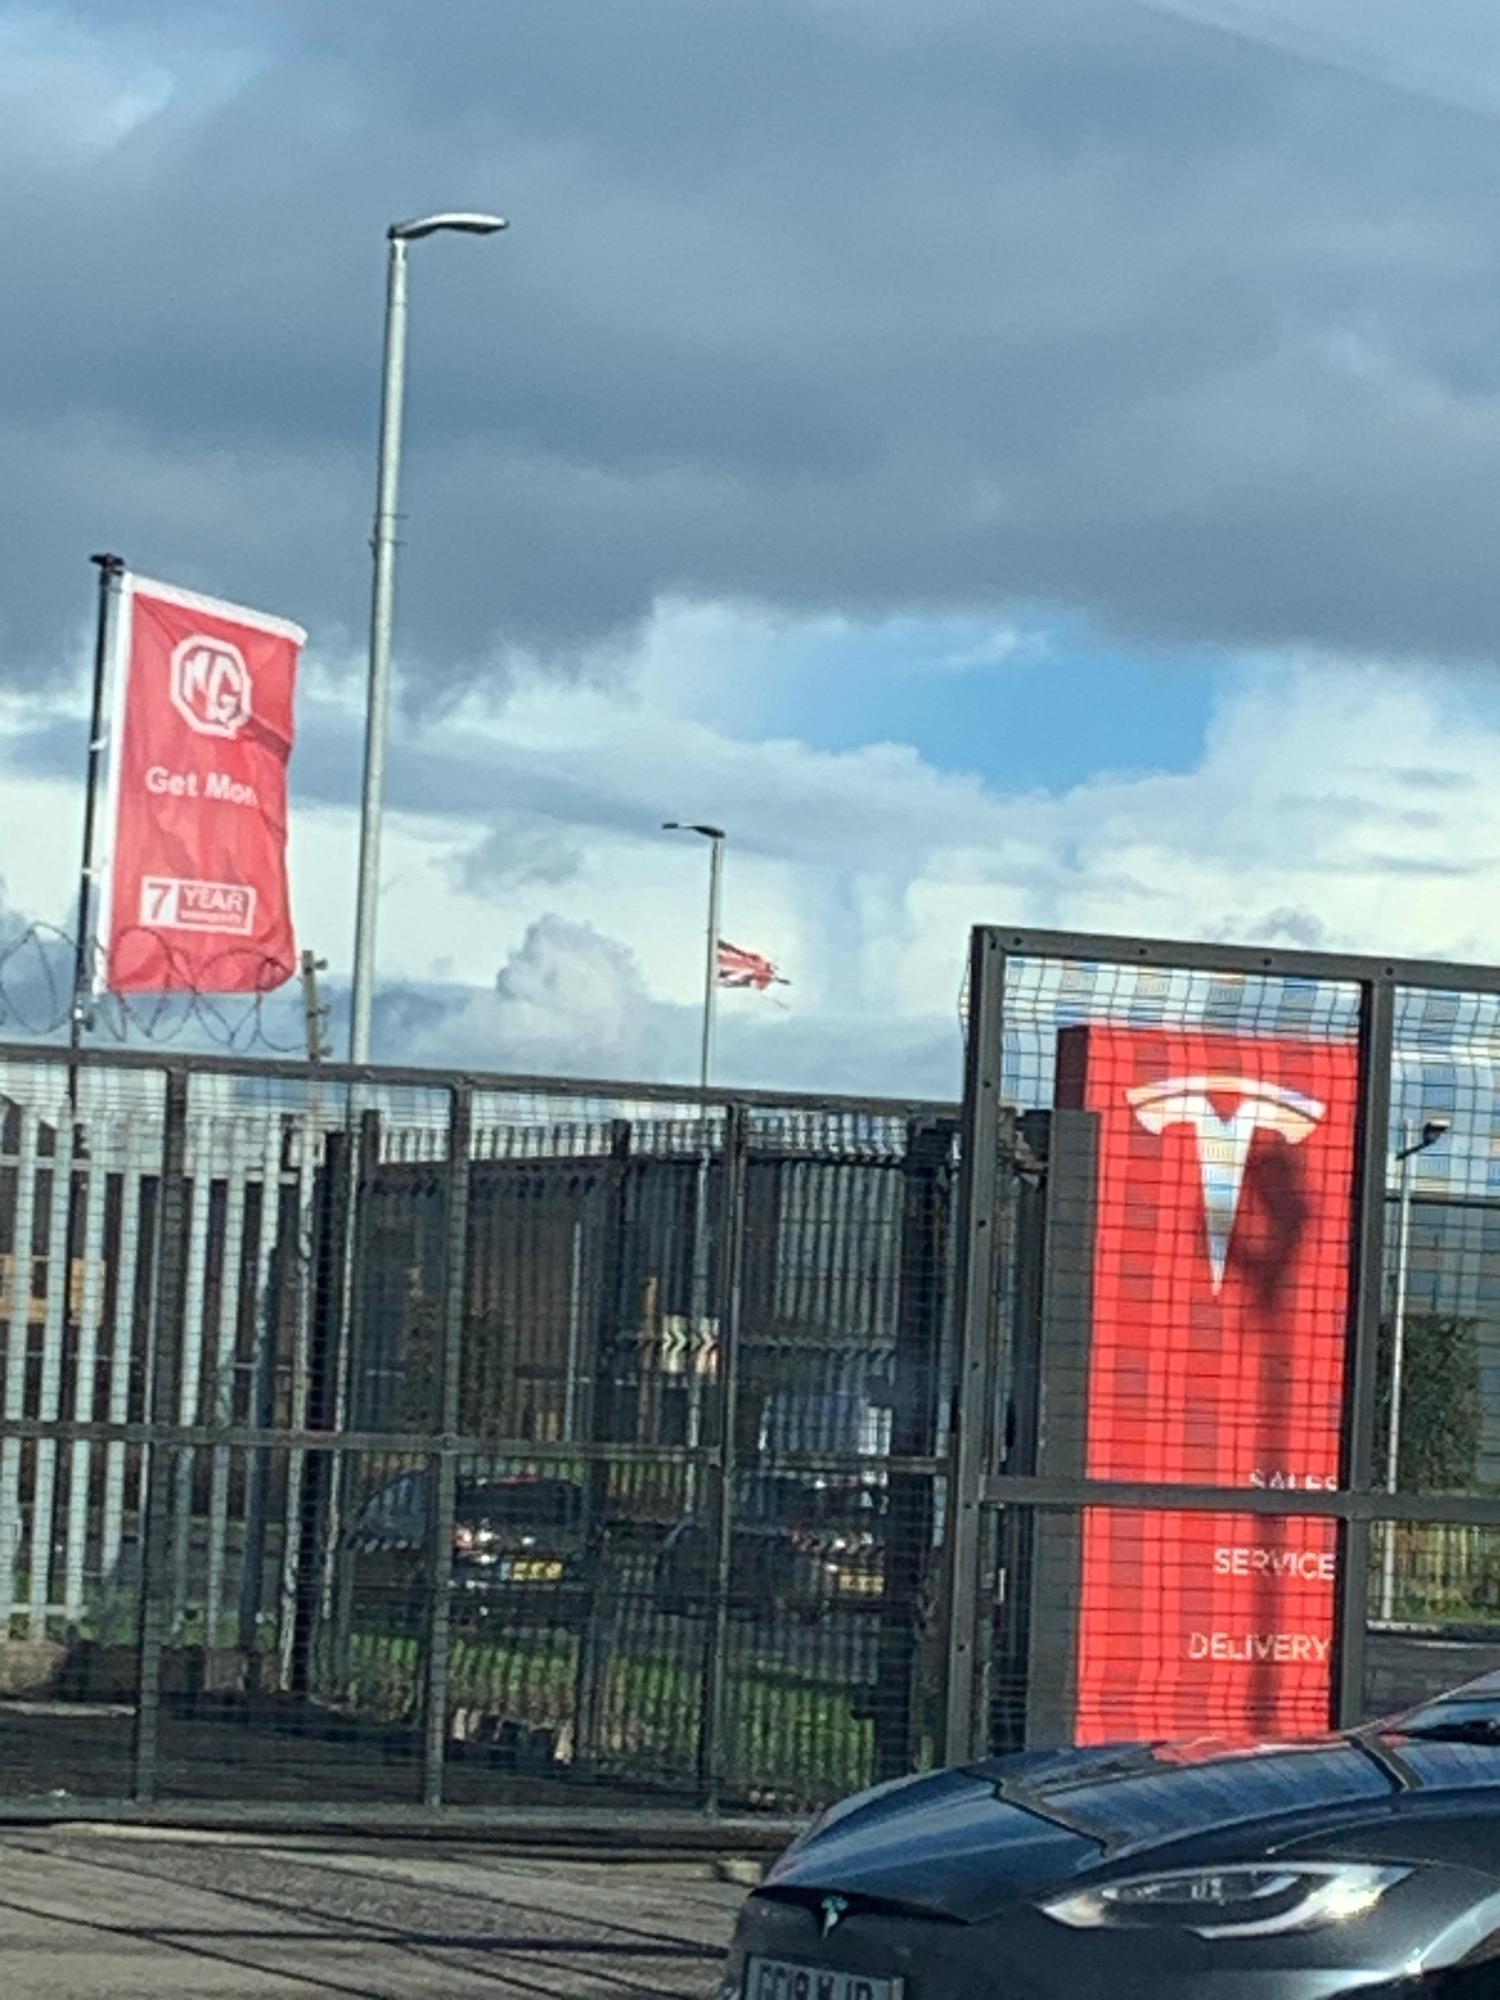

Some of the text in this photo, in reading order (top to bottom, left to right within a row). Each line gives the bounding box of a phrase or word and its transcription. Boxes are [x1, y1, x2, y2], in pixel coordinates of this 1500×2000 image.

[180, 646, 247, 727] MG
[145, 765, 198, 797] Get
[148, 882, 172, 920] 7
[184, 887, 243, 912] YEAR
[1213, 1547, 1336, 1581] SERVICE
[1187, 1632, 1331, 1662] DELIVERY
